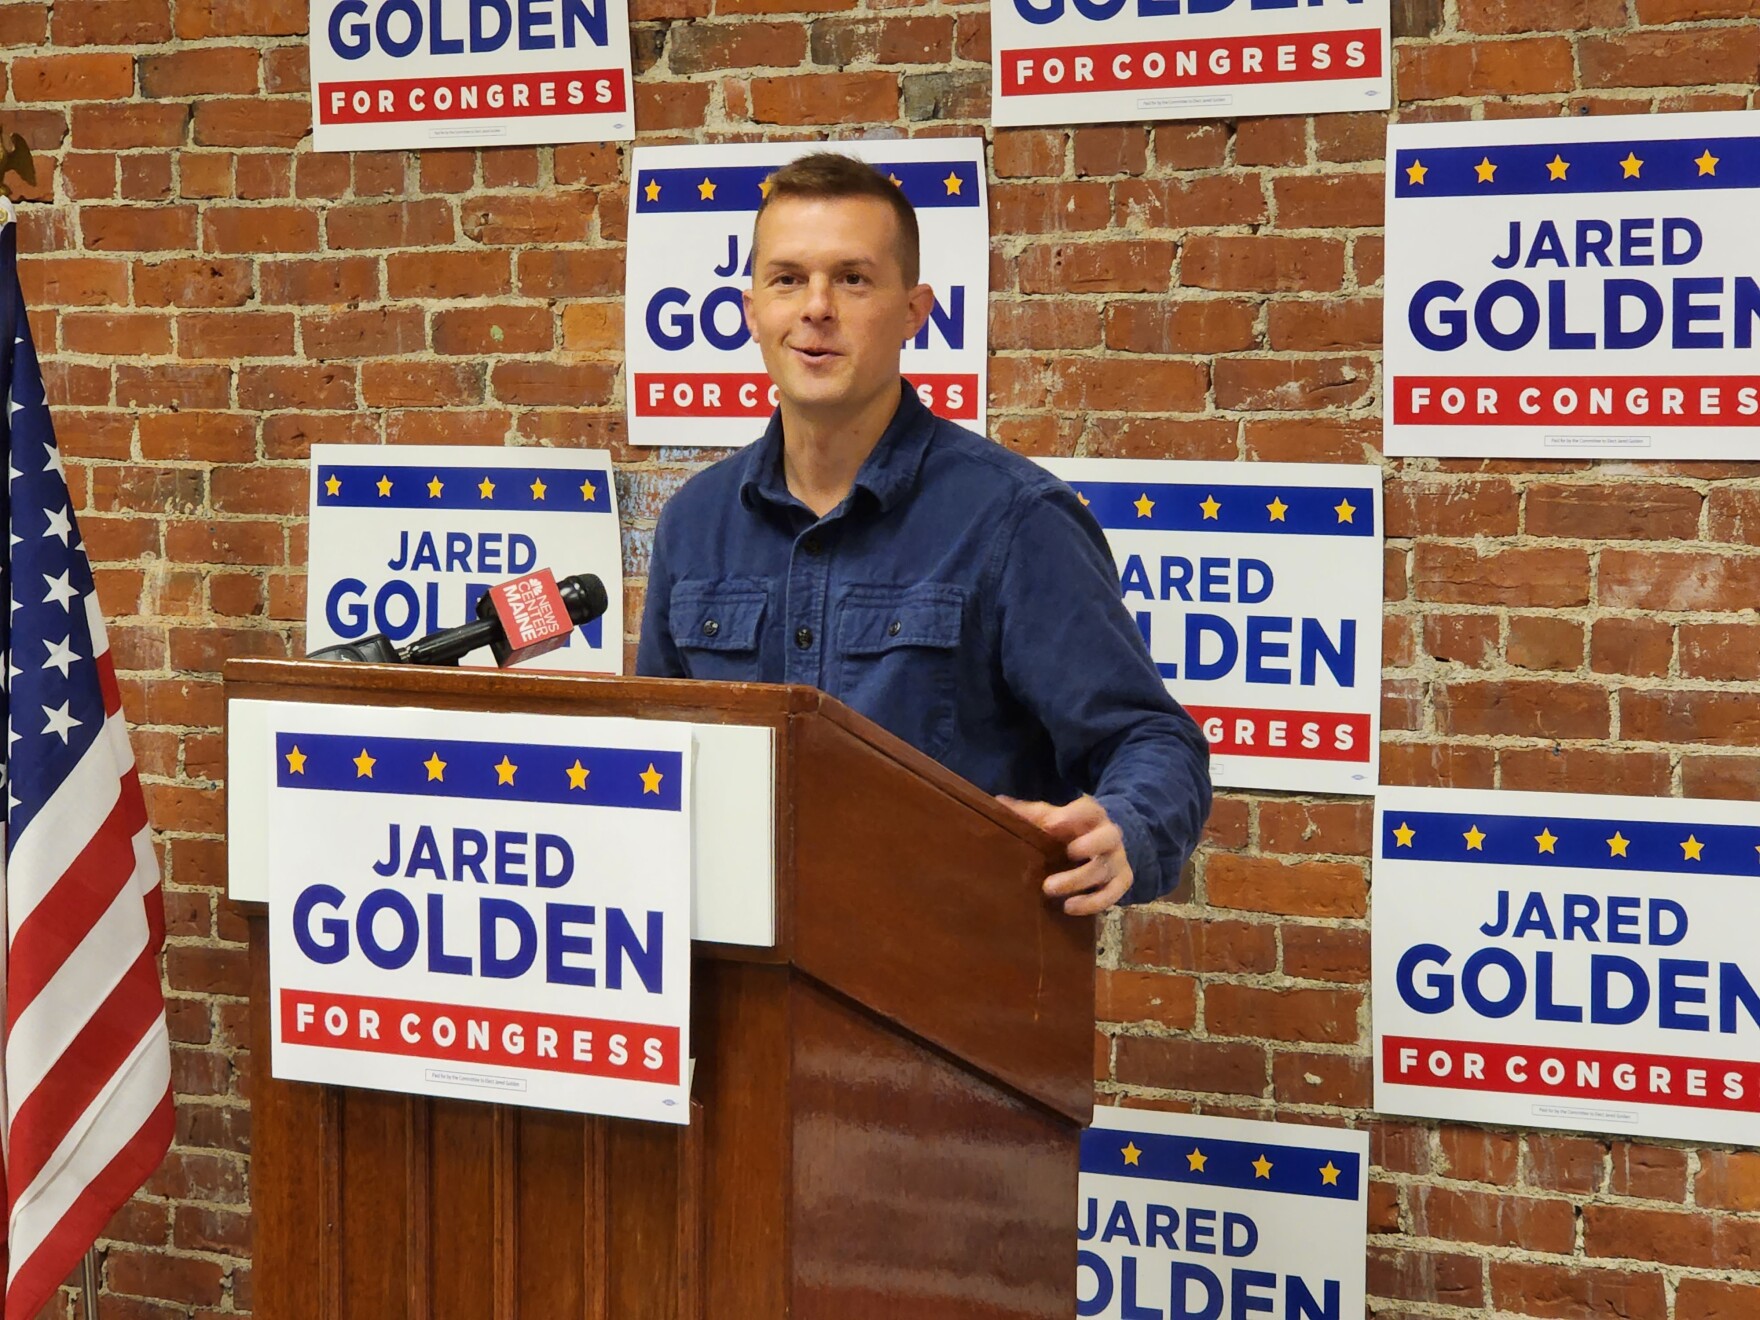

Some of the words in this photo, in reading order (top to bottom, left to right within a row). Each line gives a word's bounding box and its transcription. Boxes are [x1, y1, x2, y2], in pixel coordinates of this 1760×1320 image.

[329, 0, 608, 60] GOLDEN
[1016, 56, 1094, 85] FOR
[1112, 41, 1365, 80] CONGRESS
[331, 90, 394, 115] FOR
[408, 79, 612, 112] CONGRESS
[1492, 217, 1702, 270] JARED
[646, 287, 965, 351] GON
[649, 382, 721, 408] FOR
[1411, 387, 1498, 415] FOR
[1519, 387, 1760, 415] CONGRES
[388, 531, 537, 575] JARED
[1119, 554, 1274, 604] ARED
[502, 584, 538, 643] MAINE
[518, 581, 549, 637] CENTER
[536, 594, 560, 633] NEWS
[1134, 611, 1356, 688] LDEN
[1202, 717, 1354, 751] GRESS
[374, 823, 575, 888] JARED
[293, 884, 663, 993] GOLDEN
[1479, 890, 1688, 947] JARED
[296, 1002, 380, 1040] FOR
[399, 1012, 663, 1070] CONGRESS
[1400, 1048, 1485, 1080] FOR
[1505, 1055, 1760, 1100] CONGRES
[1077, 1197, 1258, 1257] JARED
[1076, 1249, 1341, 1320] OLDEN
